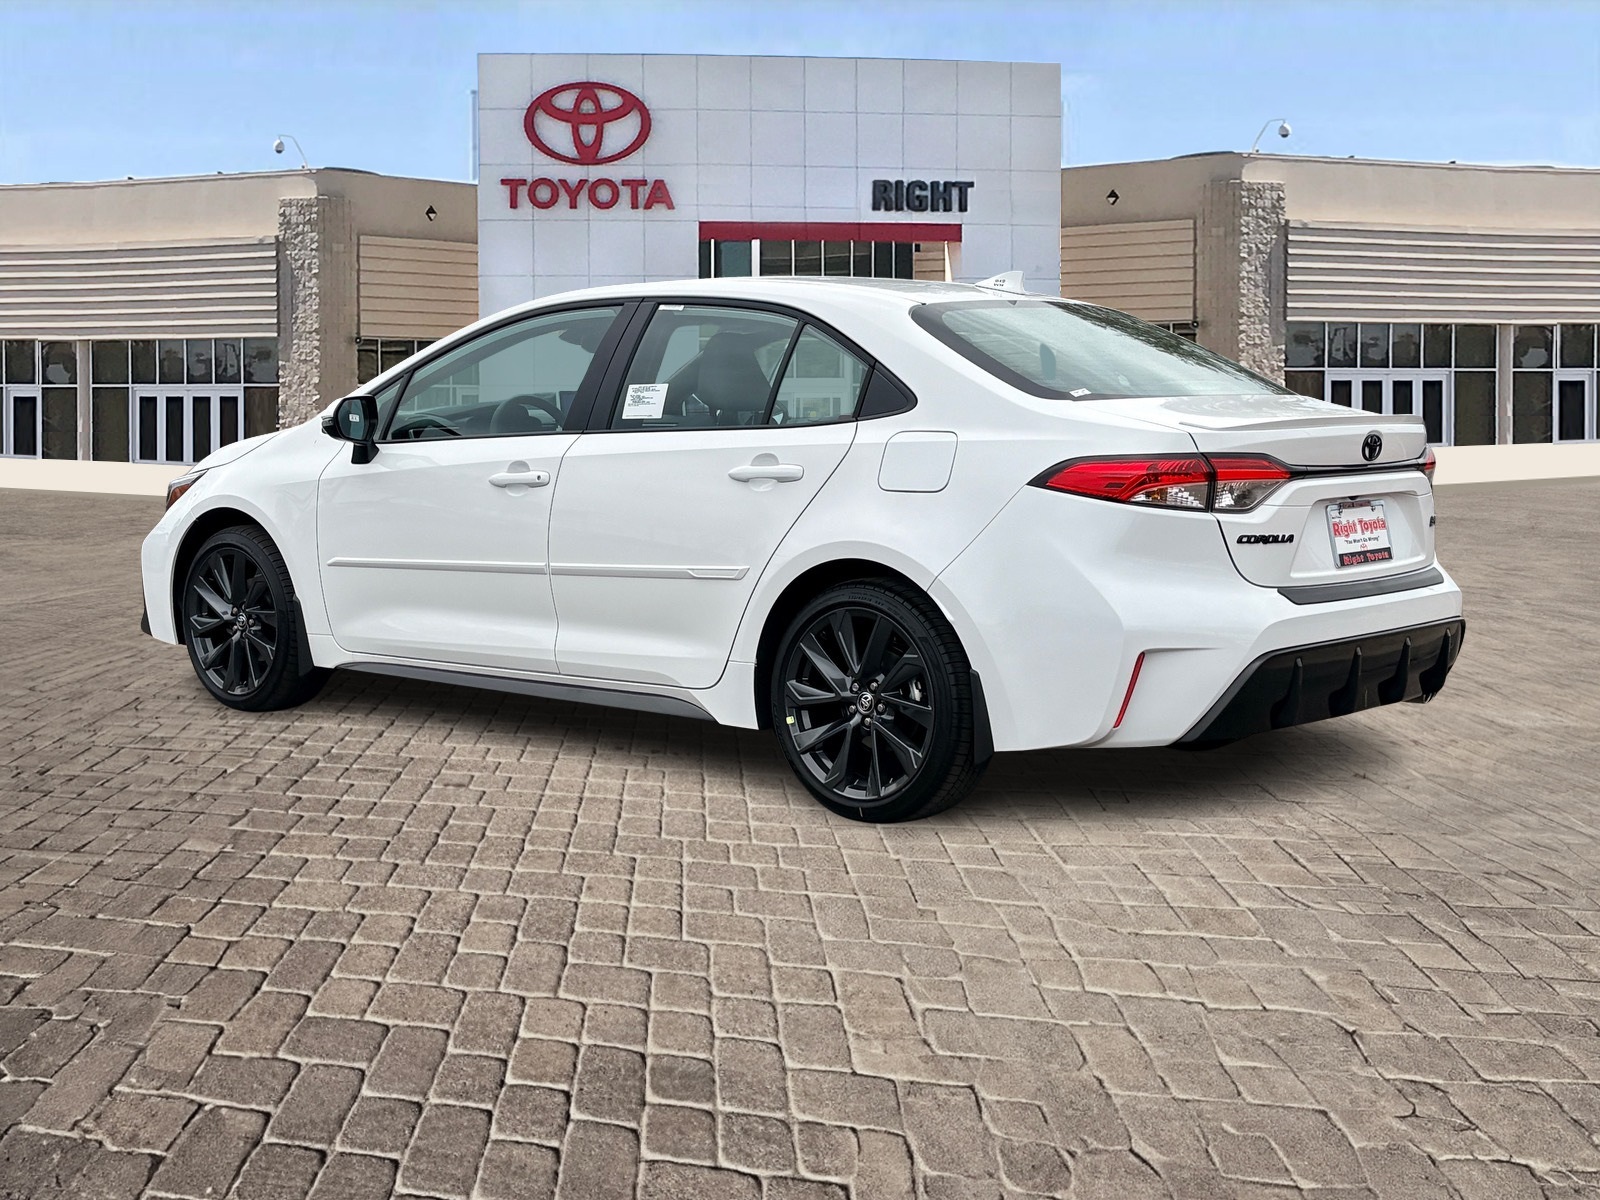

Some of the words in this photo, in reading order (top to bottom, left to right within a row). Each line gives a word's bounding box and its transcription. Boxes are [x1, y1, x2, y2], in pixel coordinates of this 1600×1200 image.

[500, 178, 675, 210] TOYOTA
[871, 179, 975, 213] RIGHT
[1236, 534, 1294, 544] COROLLA
[1332, 520, 1357, 538] Right
[1357, 517, 1387, 534] Toyota
